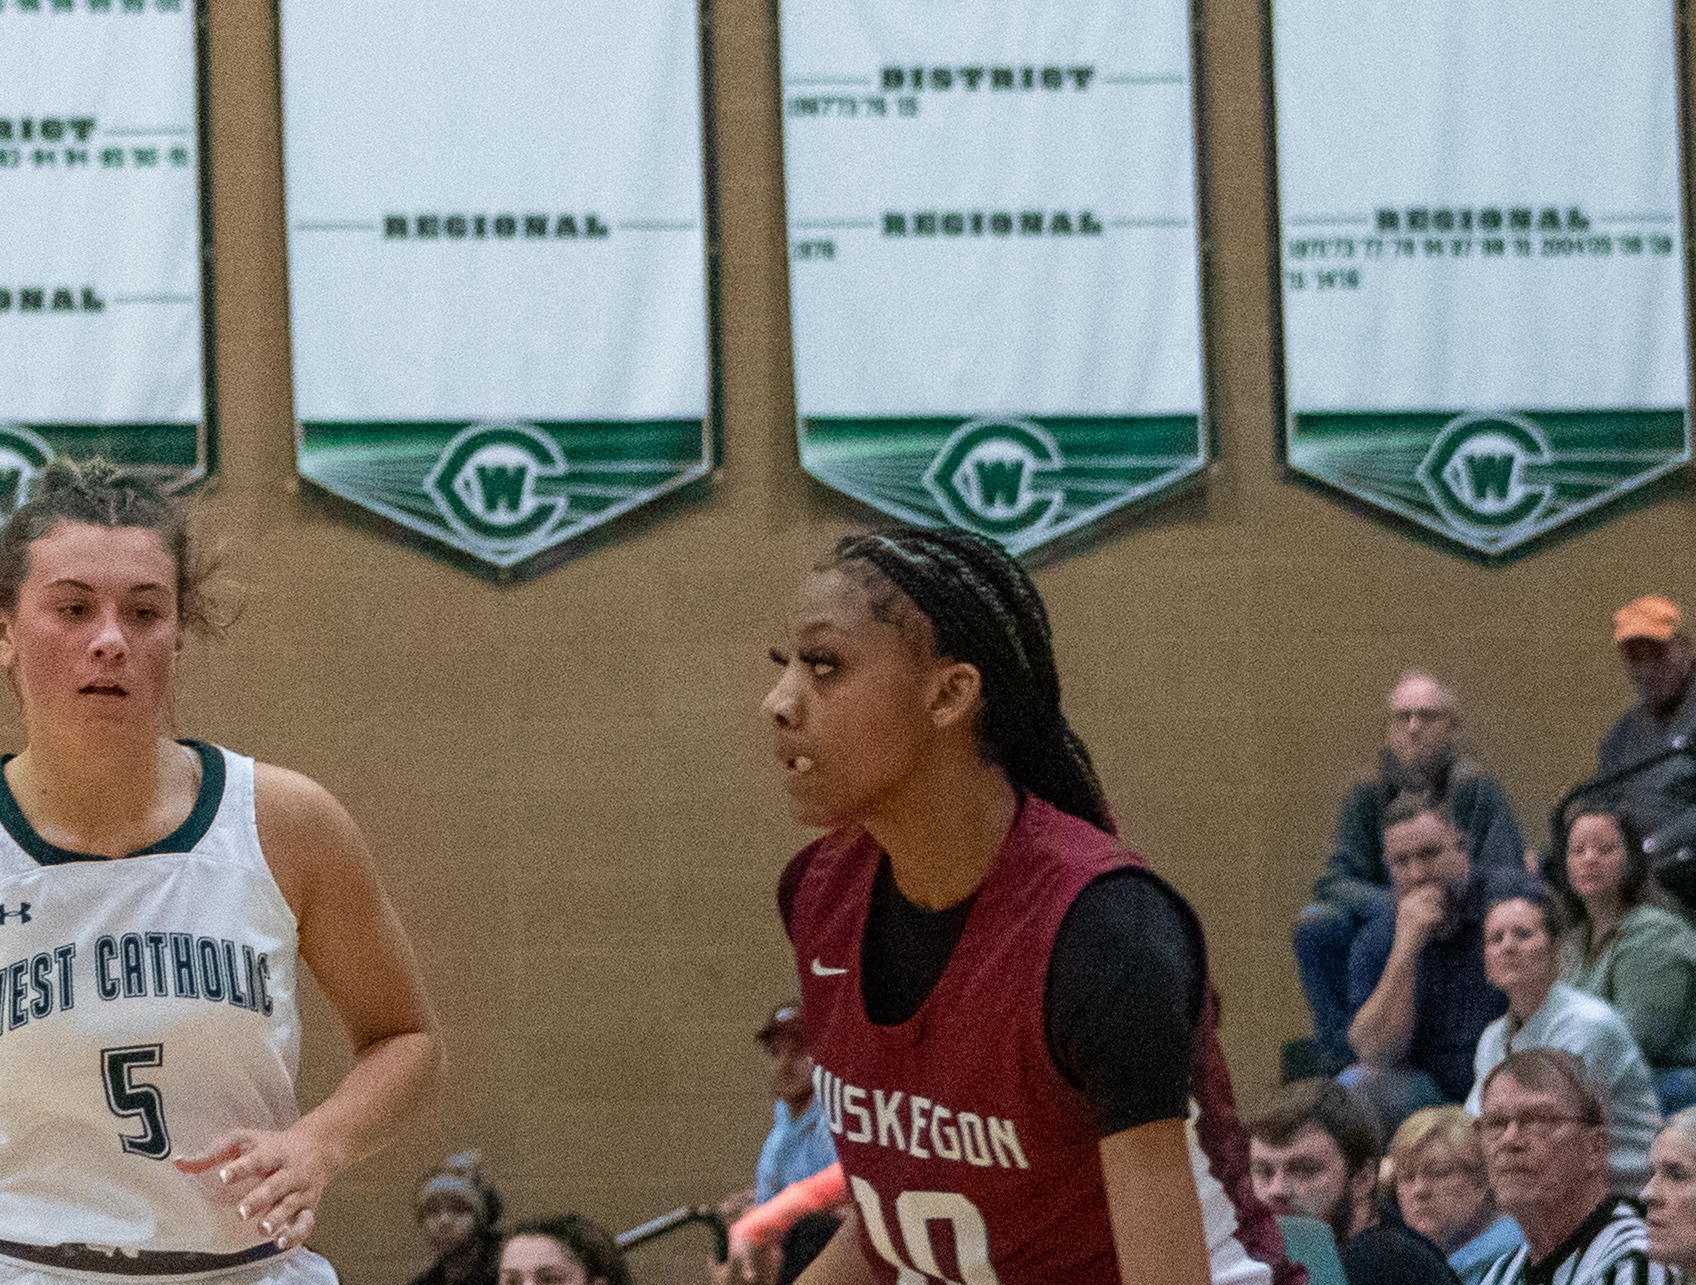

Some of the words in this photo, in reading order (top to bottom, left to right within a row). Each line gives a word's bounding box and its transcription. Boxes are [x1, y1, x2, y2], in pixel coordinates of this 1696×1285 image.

[880, 65, 1095, 92] DISTRICT
[383, 214, 609, 240] REGIONAL
[881, 211, 1104, 237] REGIONAL
[1375, 207, 1591, 234] REGIONAL
[95, 931, 274, 1017] CATHOLIC
[101, 1043, 171, 1160] 5
